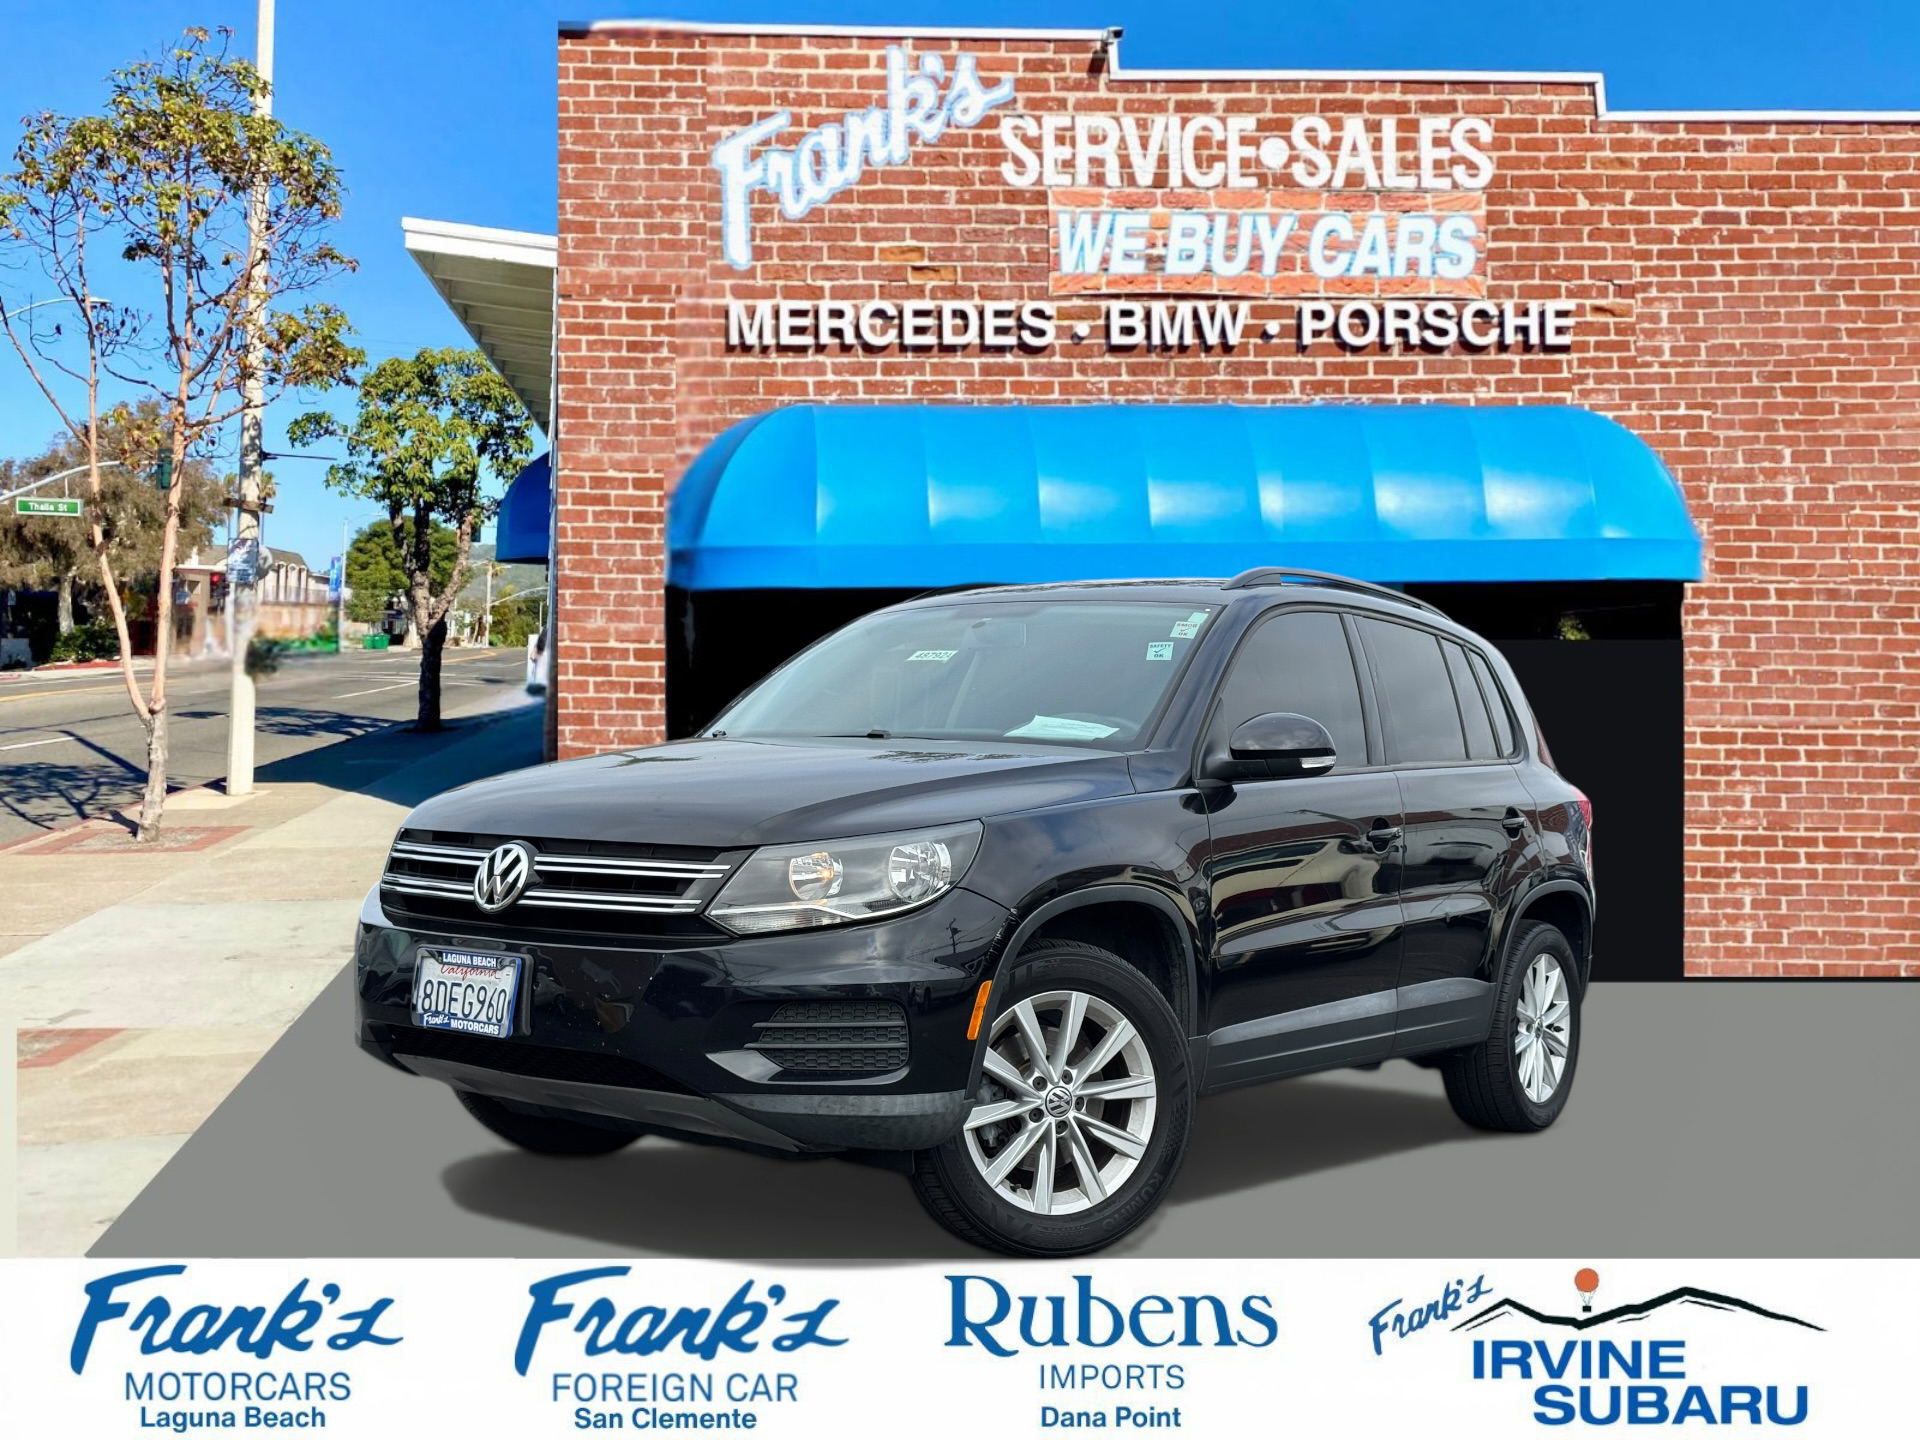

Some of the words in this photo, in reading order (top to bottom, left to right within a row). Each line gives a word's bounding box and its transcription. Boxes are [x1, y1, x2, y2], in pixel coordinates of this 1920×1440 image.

[713, 44, 1015, 270] Frank's
[1000, 115, 1258, 188] SERVICE
[1291, 116, 1494, 188] SALES
[1056, 210, 1152, 275] WE
[1164, 210, 1298, 276] BUY
[1308, 214, 1480, 279] CARS
[727, 300, 1057, 350] MERCEDES
[1107, 300, 1249, 350] BMW
[1300, 300, 1577, 350] PORSCHE
[57, 503, 68, 512] St
[442, 952, 472, 966] LAGUNA
[472, 955, 497, 968] BEACH
[421, 979, 508, 1024] 8DEG960
[450, 1018, 500, 1035] MOTORCARS
